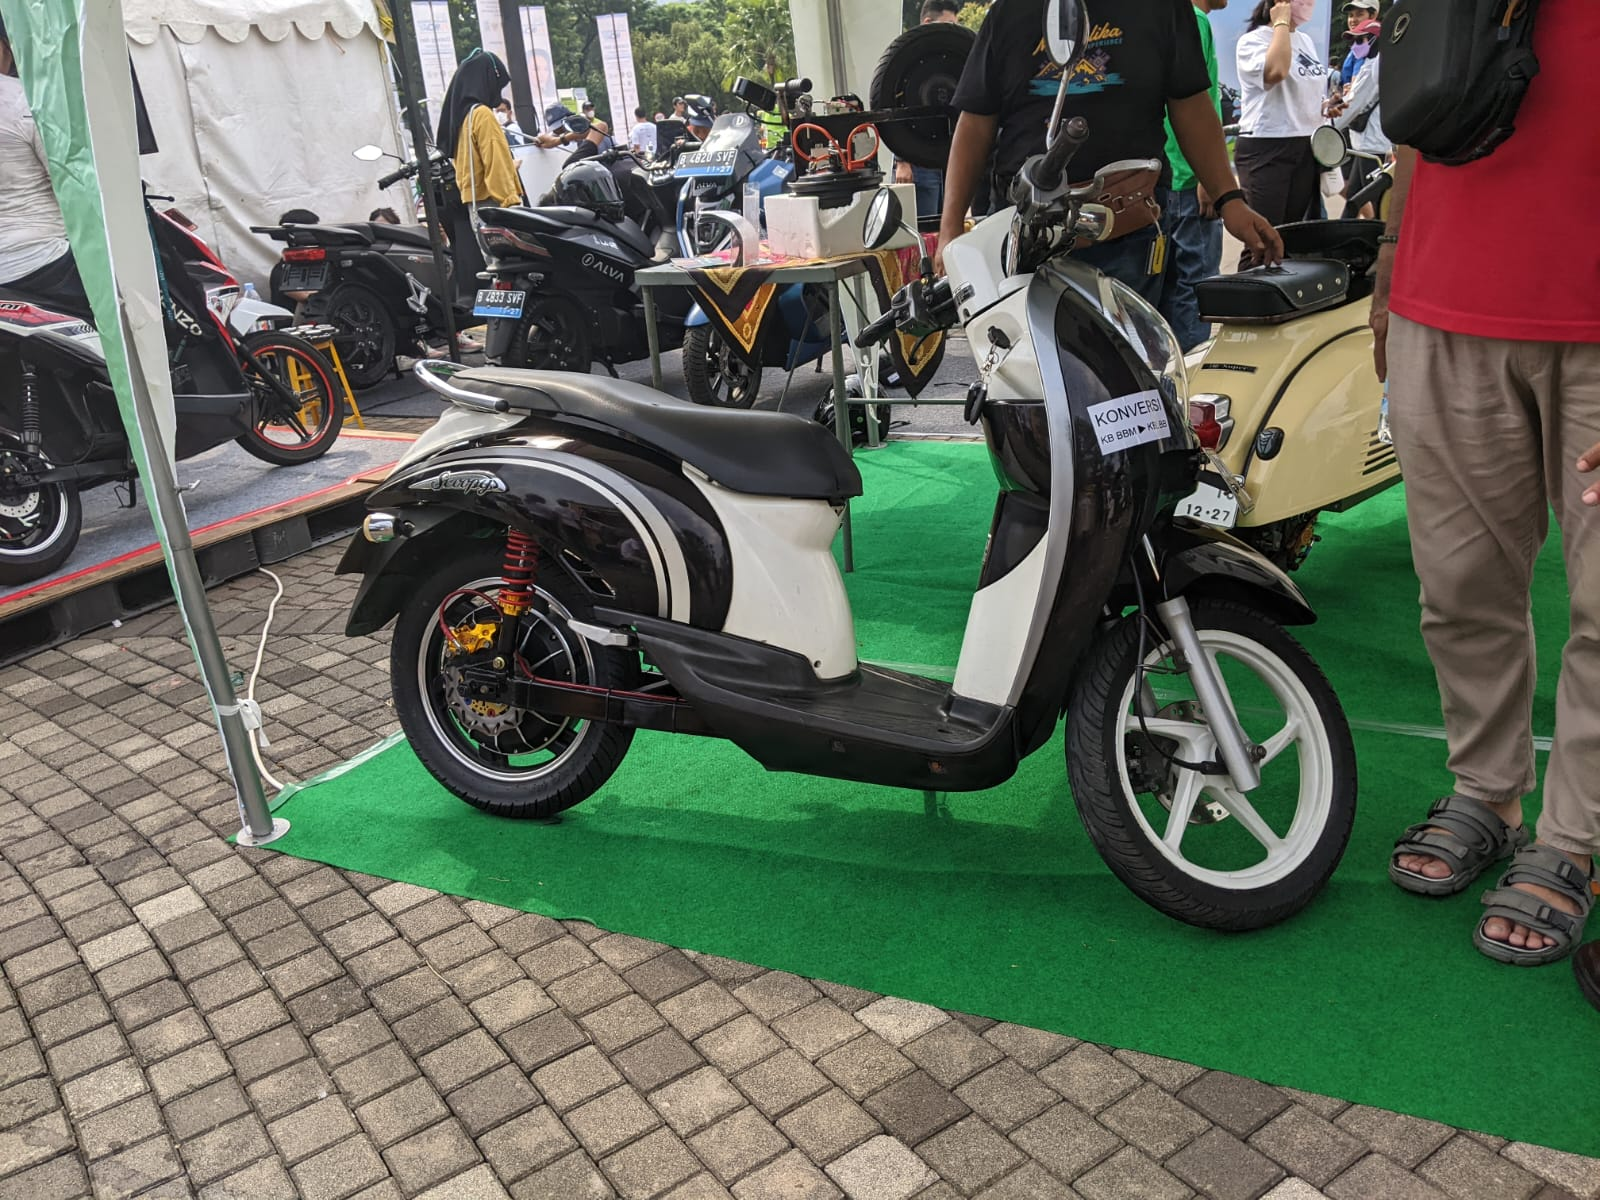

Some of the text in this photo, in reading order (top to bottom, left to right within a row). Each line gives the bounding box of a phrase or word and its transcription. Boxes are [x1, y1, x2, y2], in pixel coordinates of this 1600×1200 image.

[680, 151, 735, 165] B 4820 SVF
[593, 261, 624, 283] ALVA
[477, 291, 523, 304] B 4833 SVF
[1094, 398, 1162, 427] KONVERSI
[1100, 433, 1115, 446] KB
[1116, 427, 1137, 441] BBM
